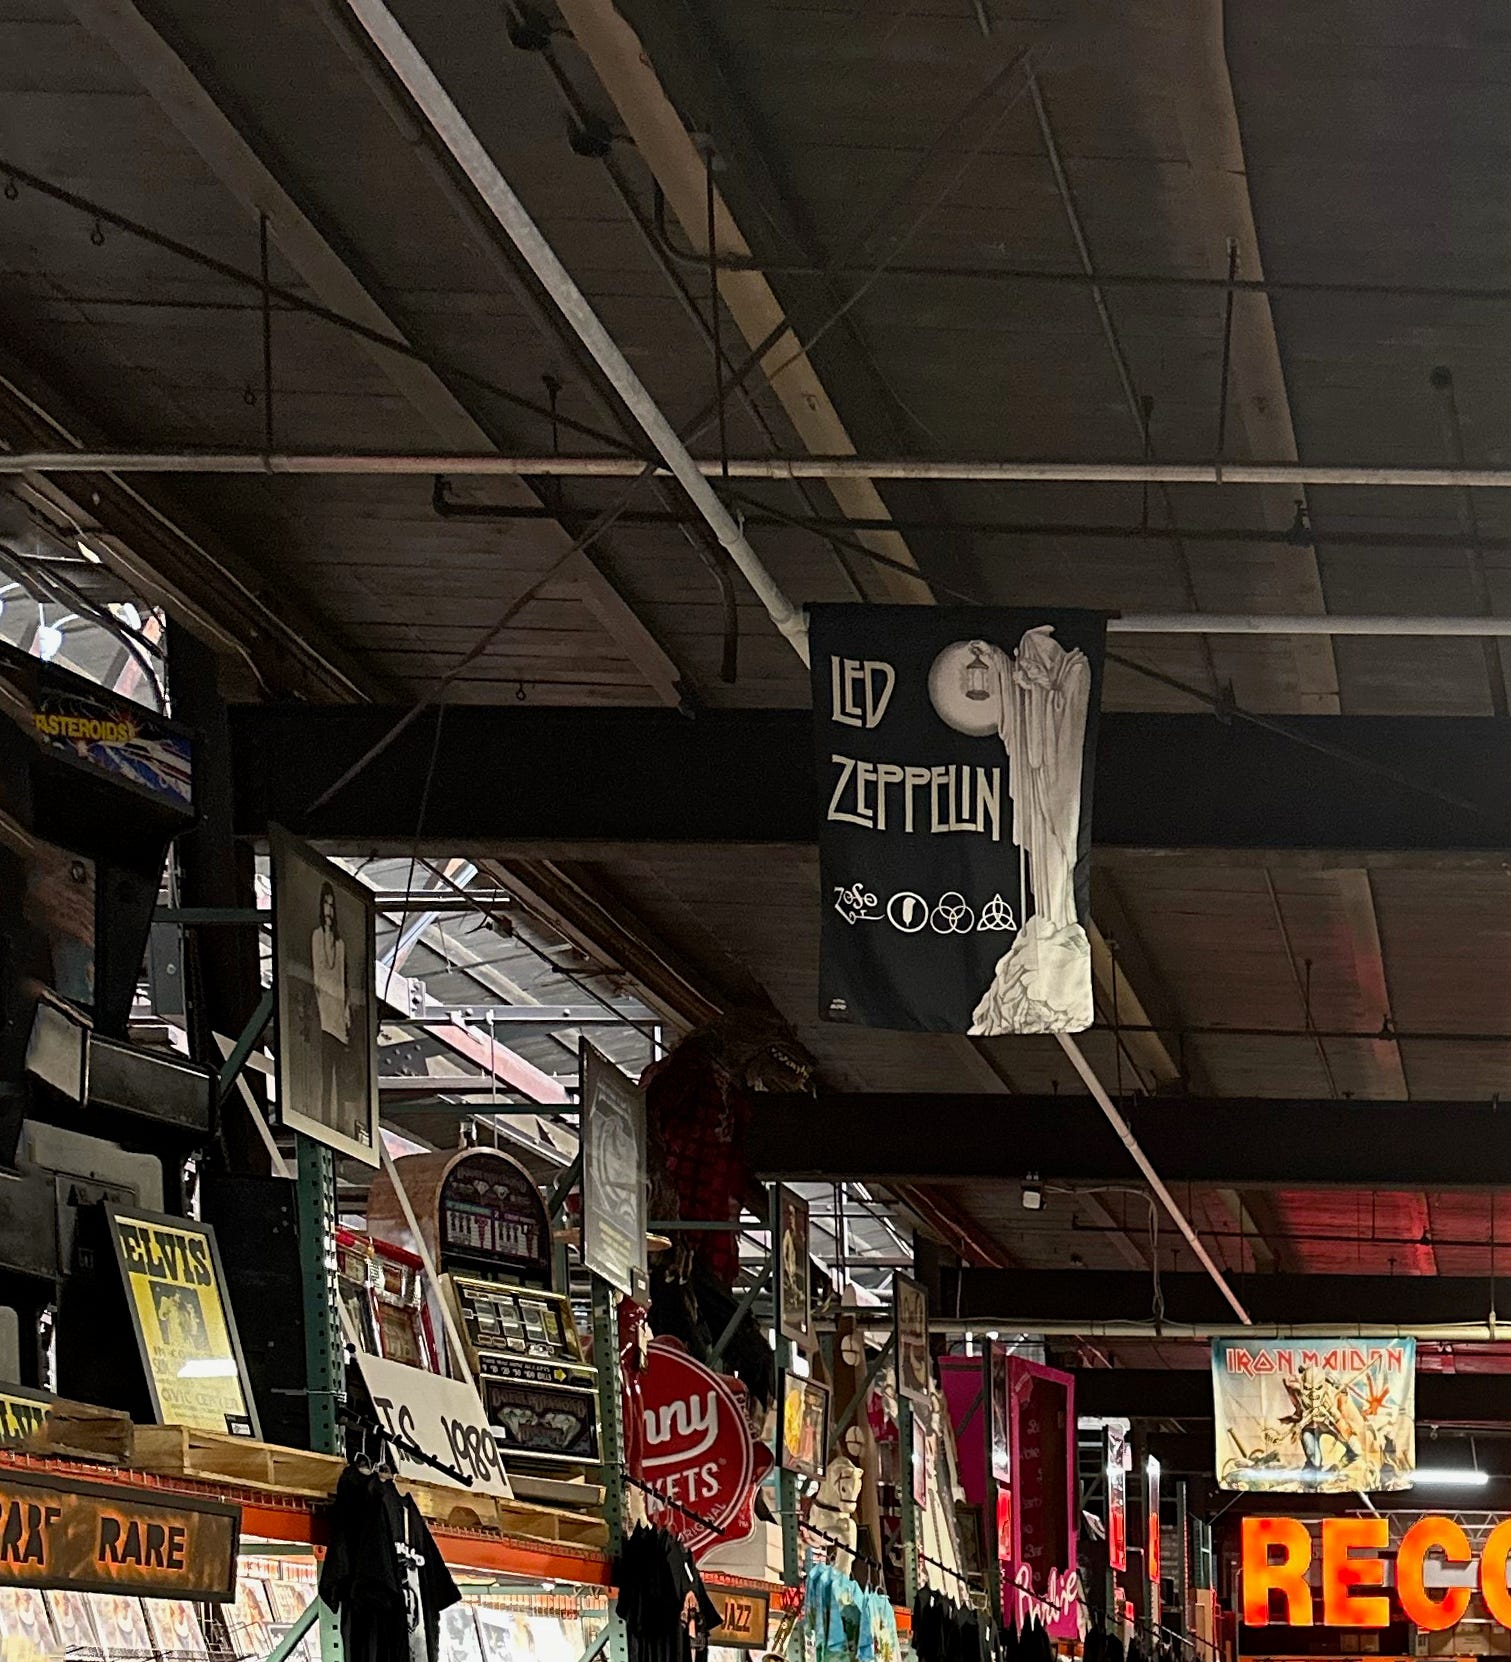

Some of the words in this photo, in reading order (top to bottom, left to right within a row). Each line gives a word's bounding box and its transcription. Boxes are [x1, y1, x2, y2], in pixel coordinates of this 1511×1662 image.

[830, 656, 894, 728] LED
[827, 755, 999, 841] ZEPPELIN
[118, 1226, 211, 1288] ELVIS
[1226, 1348, 1294, 1380] IRON
[441, 1416, 507, 1486] 1989
[99, 1516, 186, 1570] RARE
[721, 1602, 752, 1632] JAZZ
